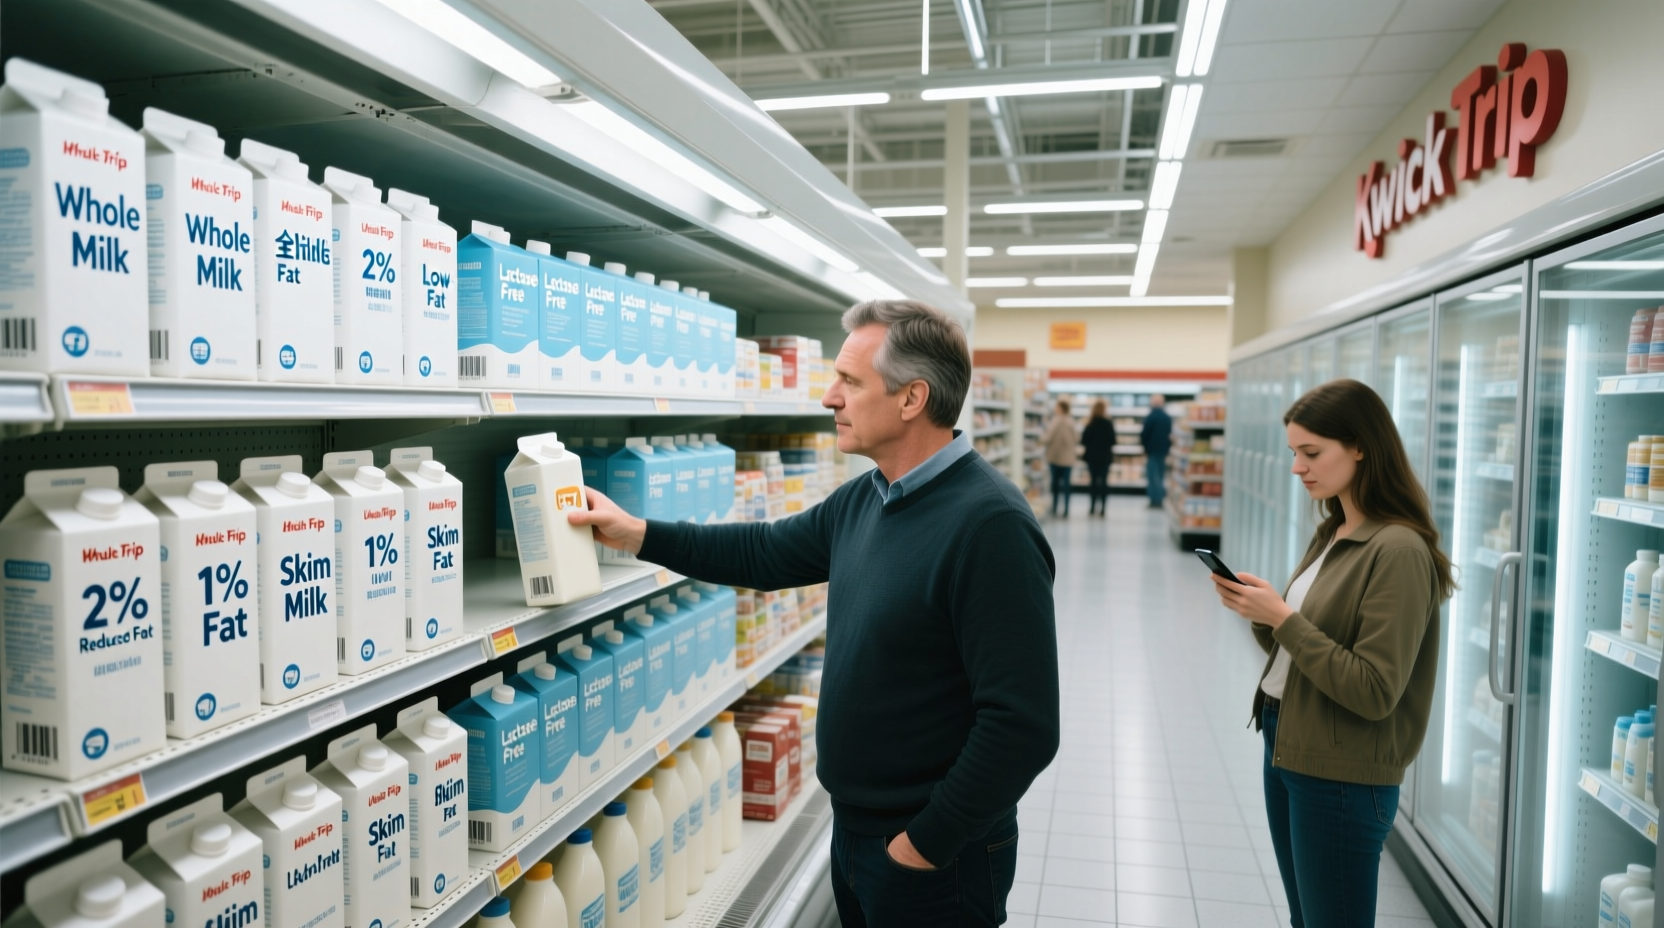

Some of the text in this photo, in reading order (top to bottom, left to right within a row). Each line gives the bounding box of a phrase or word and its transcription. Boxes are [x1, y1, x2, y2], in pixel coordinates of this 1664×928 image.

[1355, 42, 1568, 259] Kwick Trip
[55, 181, 141, 232] Whole
[185, 212, 251, 255] Whole
[72, 230, 131, 274] Milk
[362, 248, 397, 284] 2%
[197, 253, 243, 293] Milk
[277, 262, 302, 286] Fat
[427, 289, 447, 309] Fat
[500, 282, 525, 303] Free
[364, 532, 398, 568] 1%
[427, 525, 459, 549] Skim
[280, 551, 331, 587] Skim
[433, 551, 455, 570] Fat
[197, 560, 249, 606] 1%
[82, 576, 149, 631] 2%
[285, 585, 328, 622] Milk
[132, 623, 155, 642] Fat
[203, 607, 248, 648] Fat
[368, 813, 405, 847] Skim
